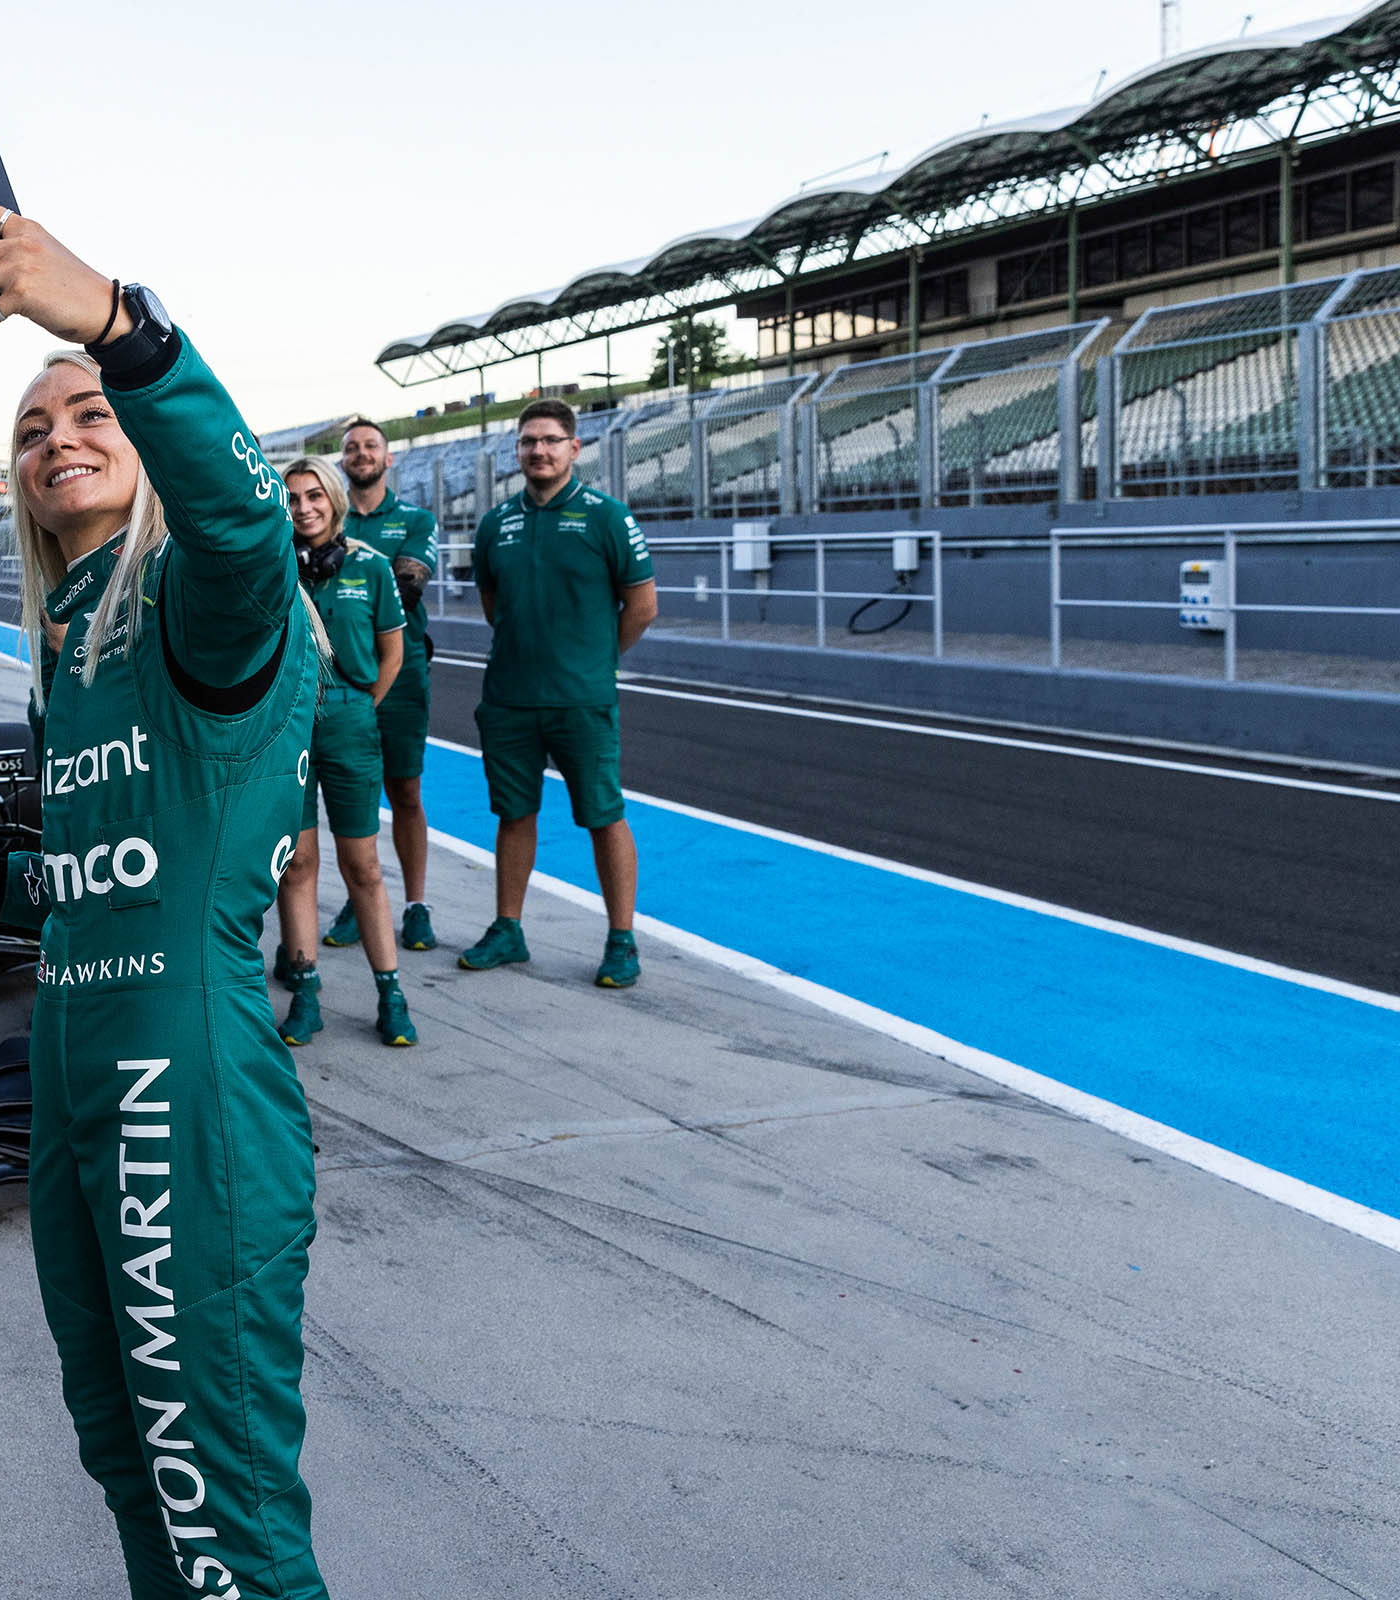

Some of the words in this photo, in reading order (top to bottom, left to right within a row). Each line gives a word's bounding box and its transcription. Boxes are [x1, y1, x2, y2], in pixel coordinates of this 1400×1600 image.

[54, 570, 94, 611] cognizant
[42, 725, 150, 796] izant
[41, 837, 159, 902] mco
[45, 952, 165, 986] HAWKINS
[116, 1058, 181, 1371] MARTIN
[137, 1395, 241, 1600] STON
